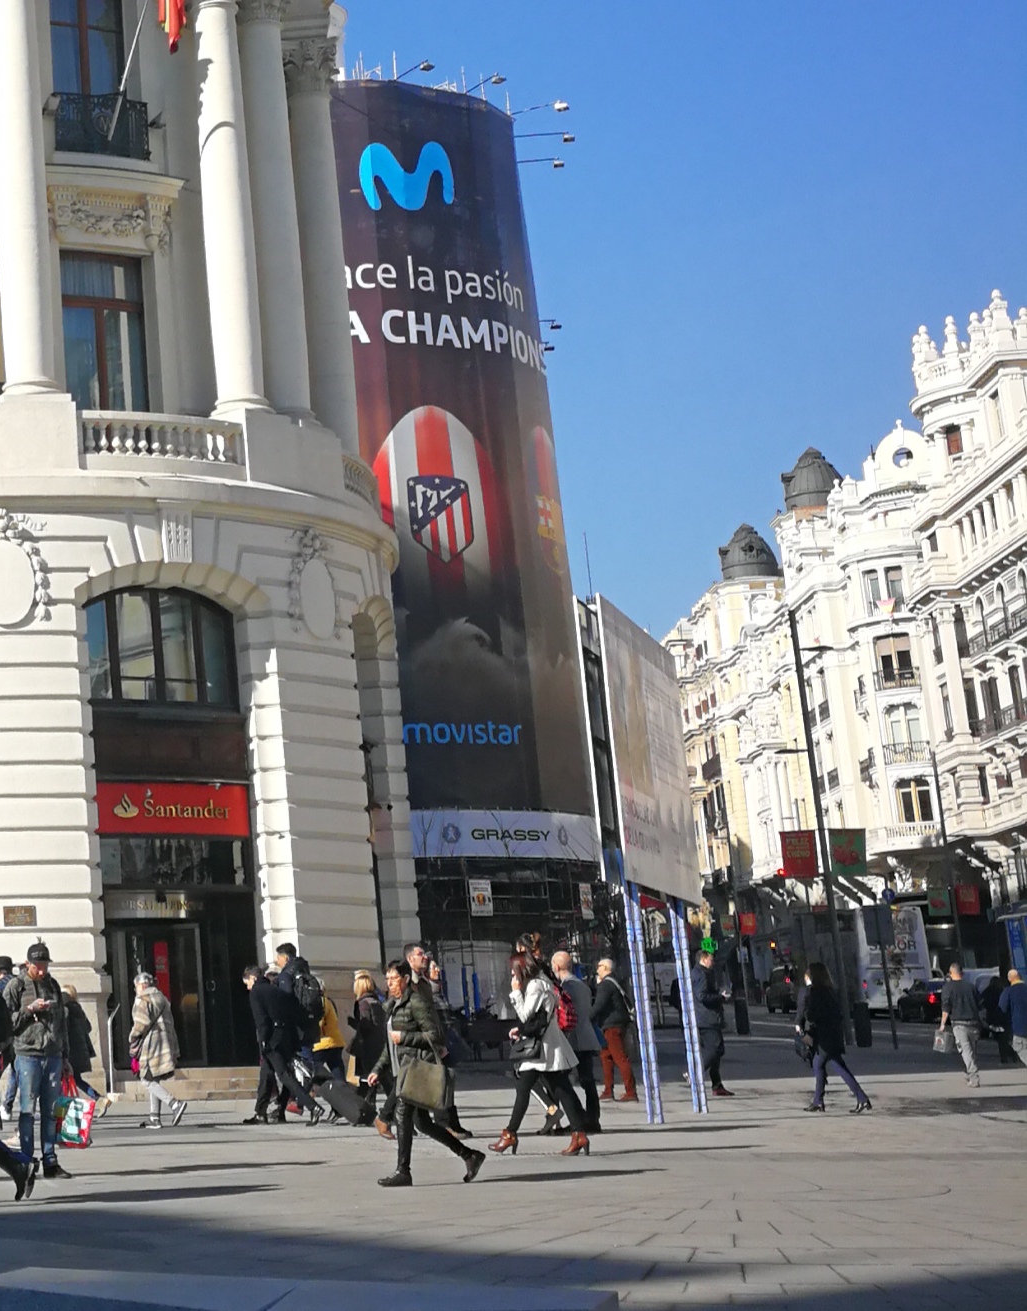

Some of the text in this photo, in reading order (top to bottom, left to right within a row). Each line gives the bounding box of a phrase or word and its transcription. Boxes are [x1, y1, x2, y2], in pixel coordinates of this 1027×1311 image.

[407, 255, 435, 292] la
[444, 269, 524, 312] pasión
[403, 720, 522, 746] movistar
[143, 798, 231, 820] Santander
[471, 828, 551, 842] GRASSY
